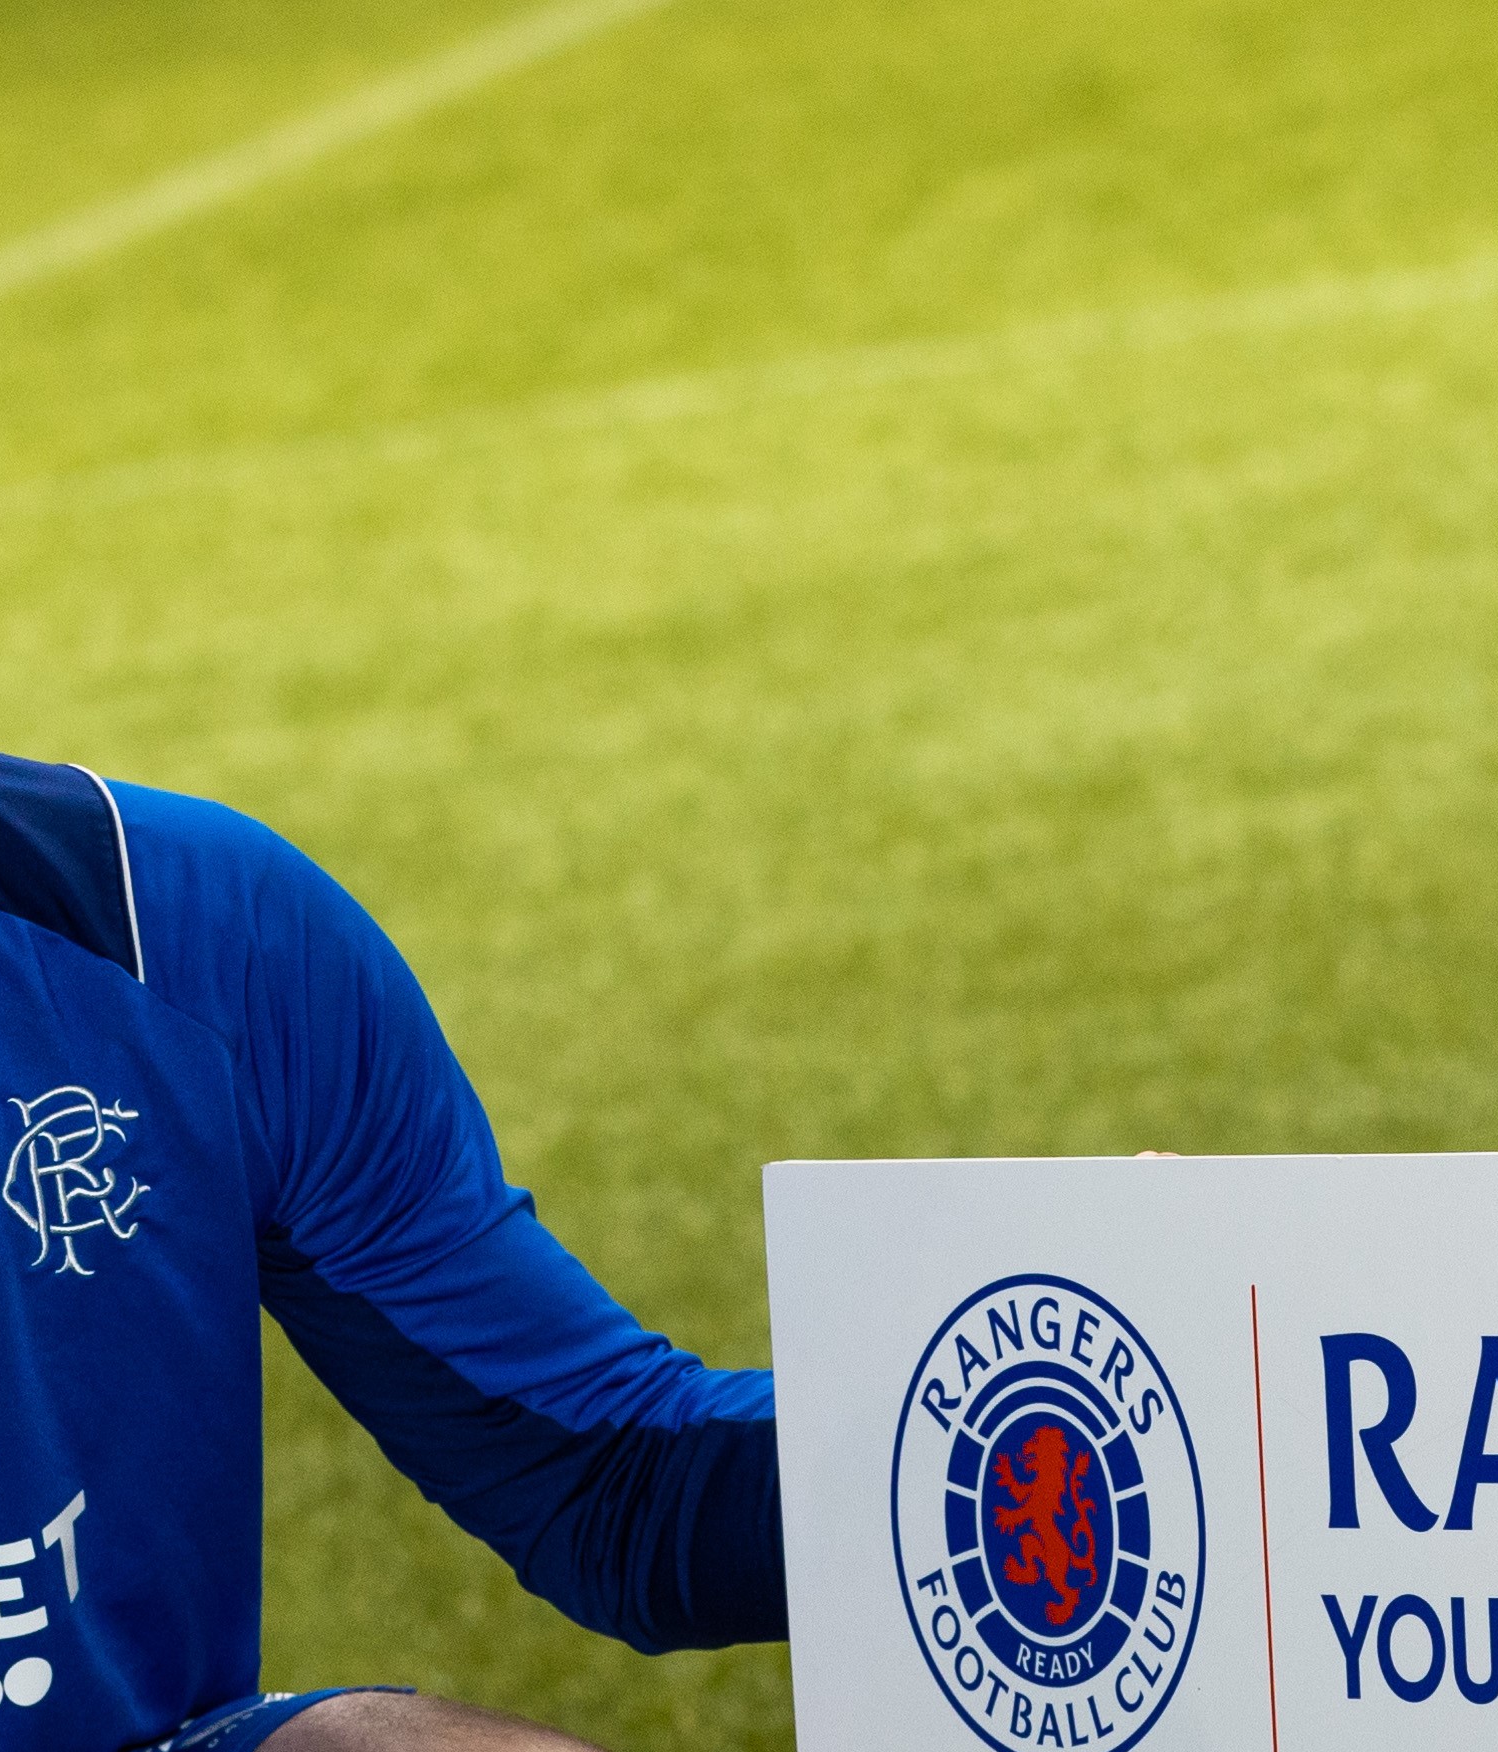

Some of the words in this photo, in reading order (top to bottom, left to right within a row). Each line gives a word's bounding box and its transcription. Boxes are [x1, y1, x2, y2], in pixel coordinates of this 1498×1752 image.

[921, 1297, 1163, 1435] RANGERS
[917, 1569, 1115, 1749] FOOTBALL
[1115, 1570, 1186, 1714] CLUB
[1016, 1641, 1096, 1682] READY
